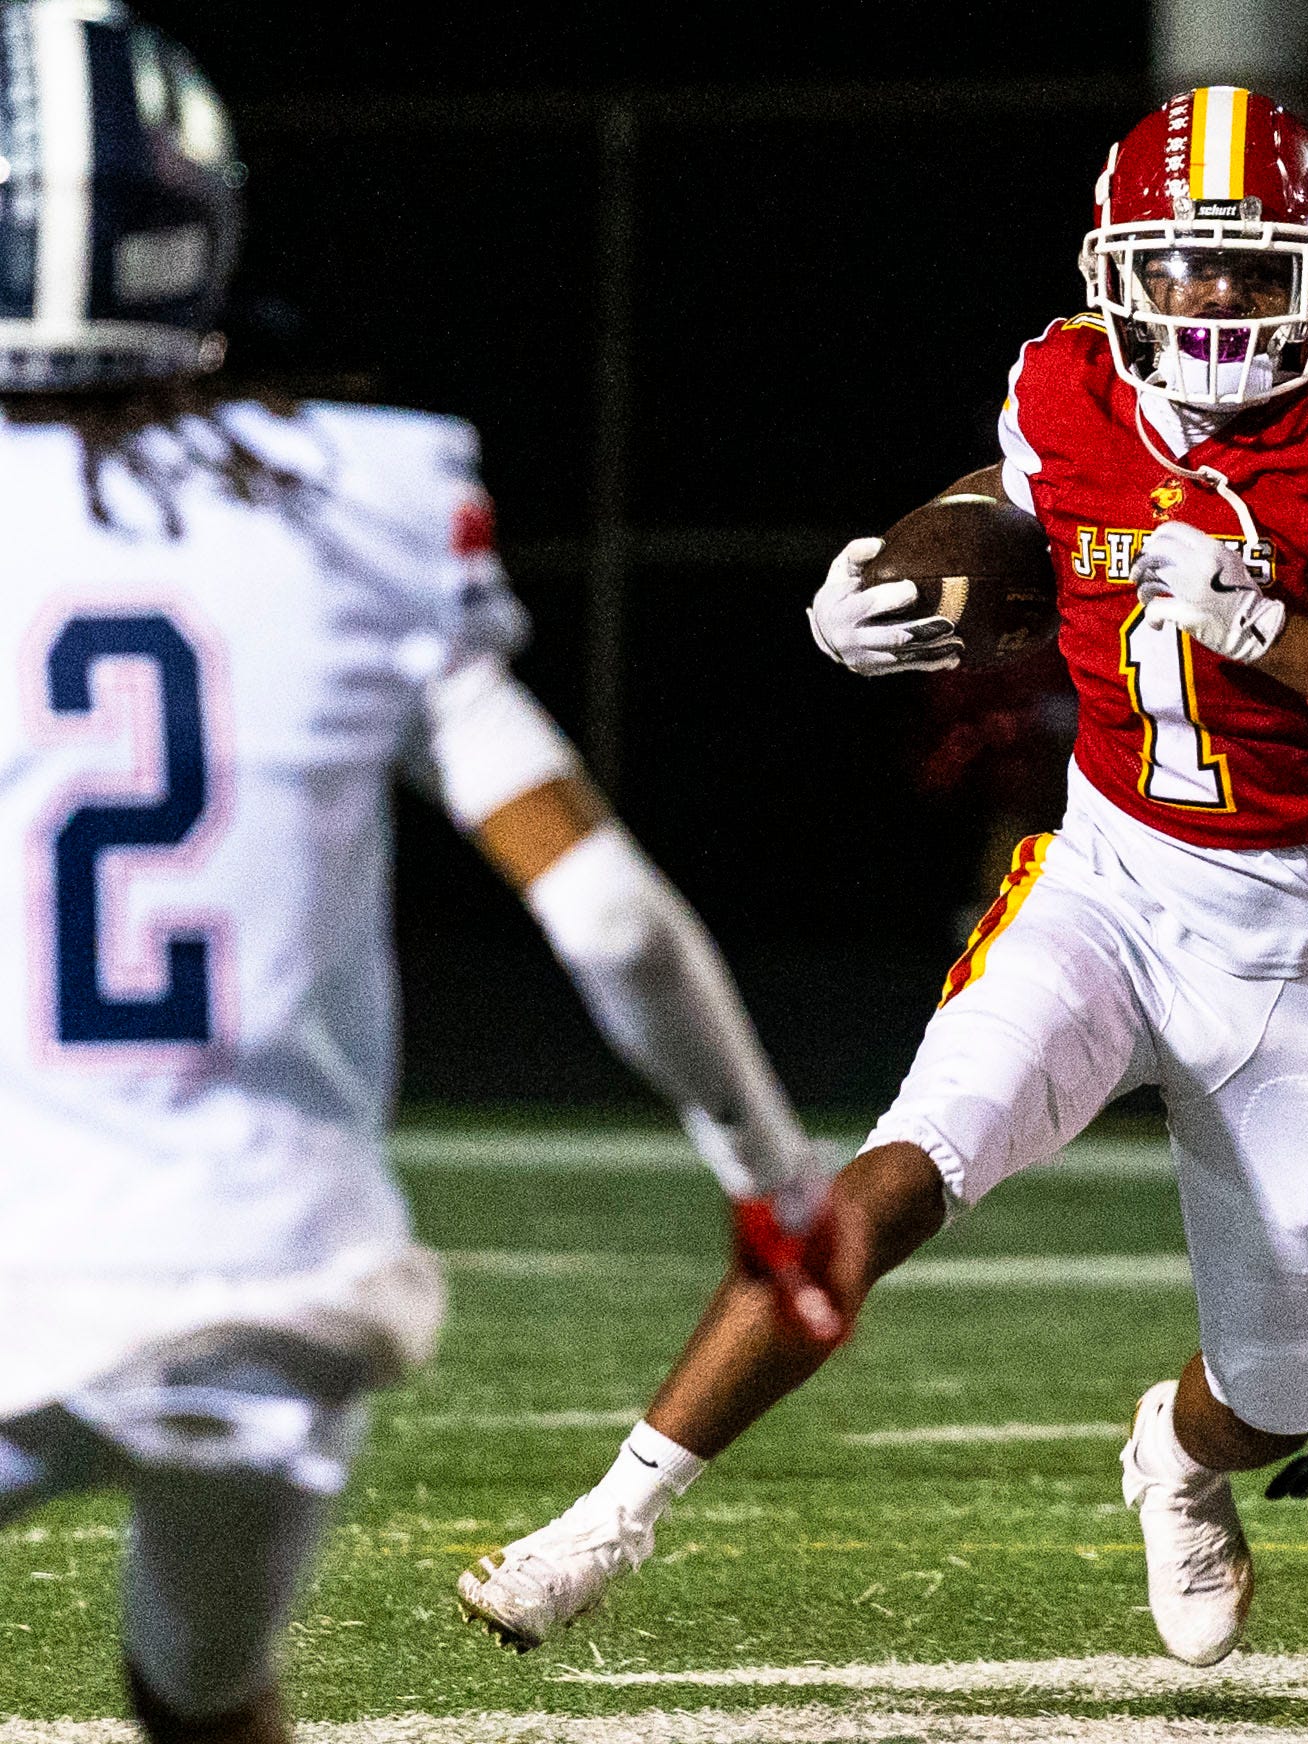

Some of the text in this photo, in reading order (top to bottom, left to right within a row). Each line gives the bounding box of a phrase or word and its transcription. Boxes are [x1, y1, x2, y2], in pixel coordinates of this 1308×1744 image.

[1198, 203, 1237, 216] schutt
[1072, 526, 1276, 588] J-HS
[1119, 600, 1236, 813] 1
[36, 604, 222, 1052] 2
